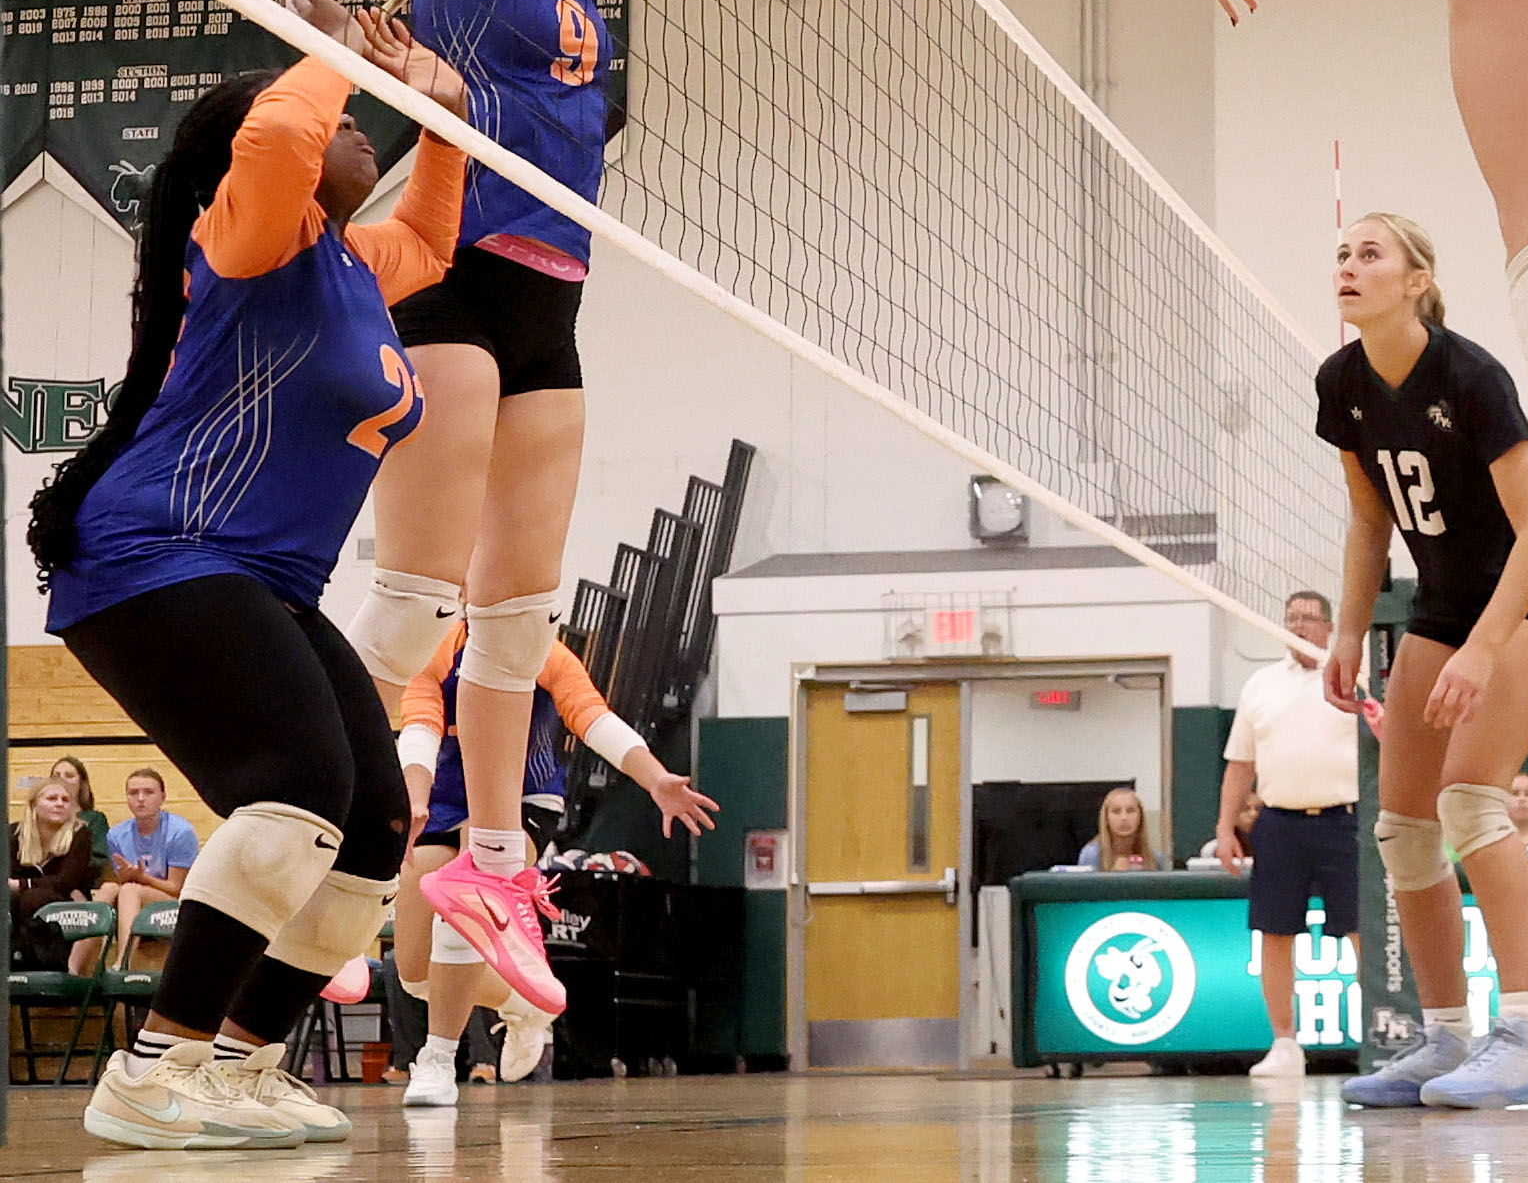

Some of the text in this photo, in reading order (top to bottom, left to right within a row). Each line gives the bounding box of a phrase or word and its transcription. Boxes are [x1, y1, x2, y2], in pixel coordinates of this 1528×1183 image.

[52, 17, 77, 29] 2007
[146, 15, 170, 26] 2010
[180, 13, 202, 24] 2011
[79, 30, 103, 42] 2014
[172, 25, 197, 37] 2017
[143, 76, 168, 88] 2001
[111, 90, 136, 102] 2014
[1377, 449, 1448, 537] 12
